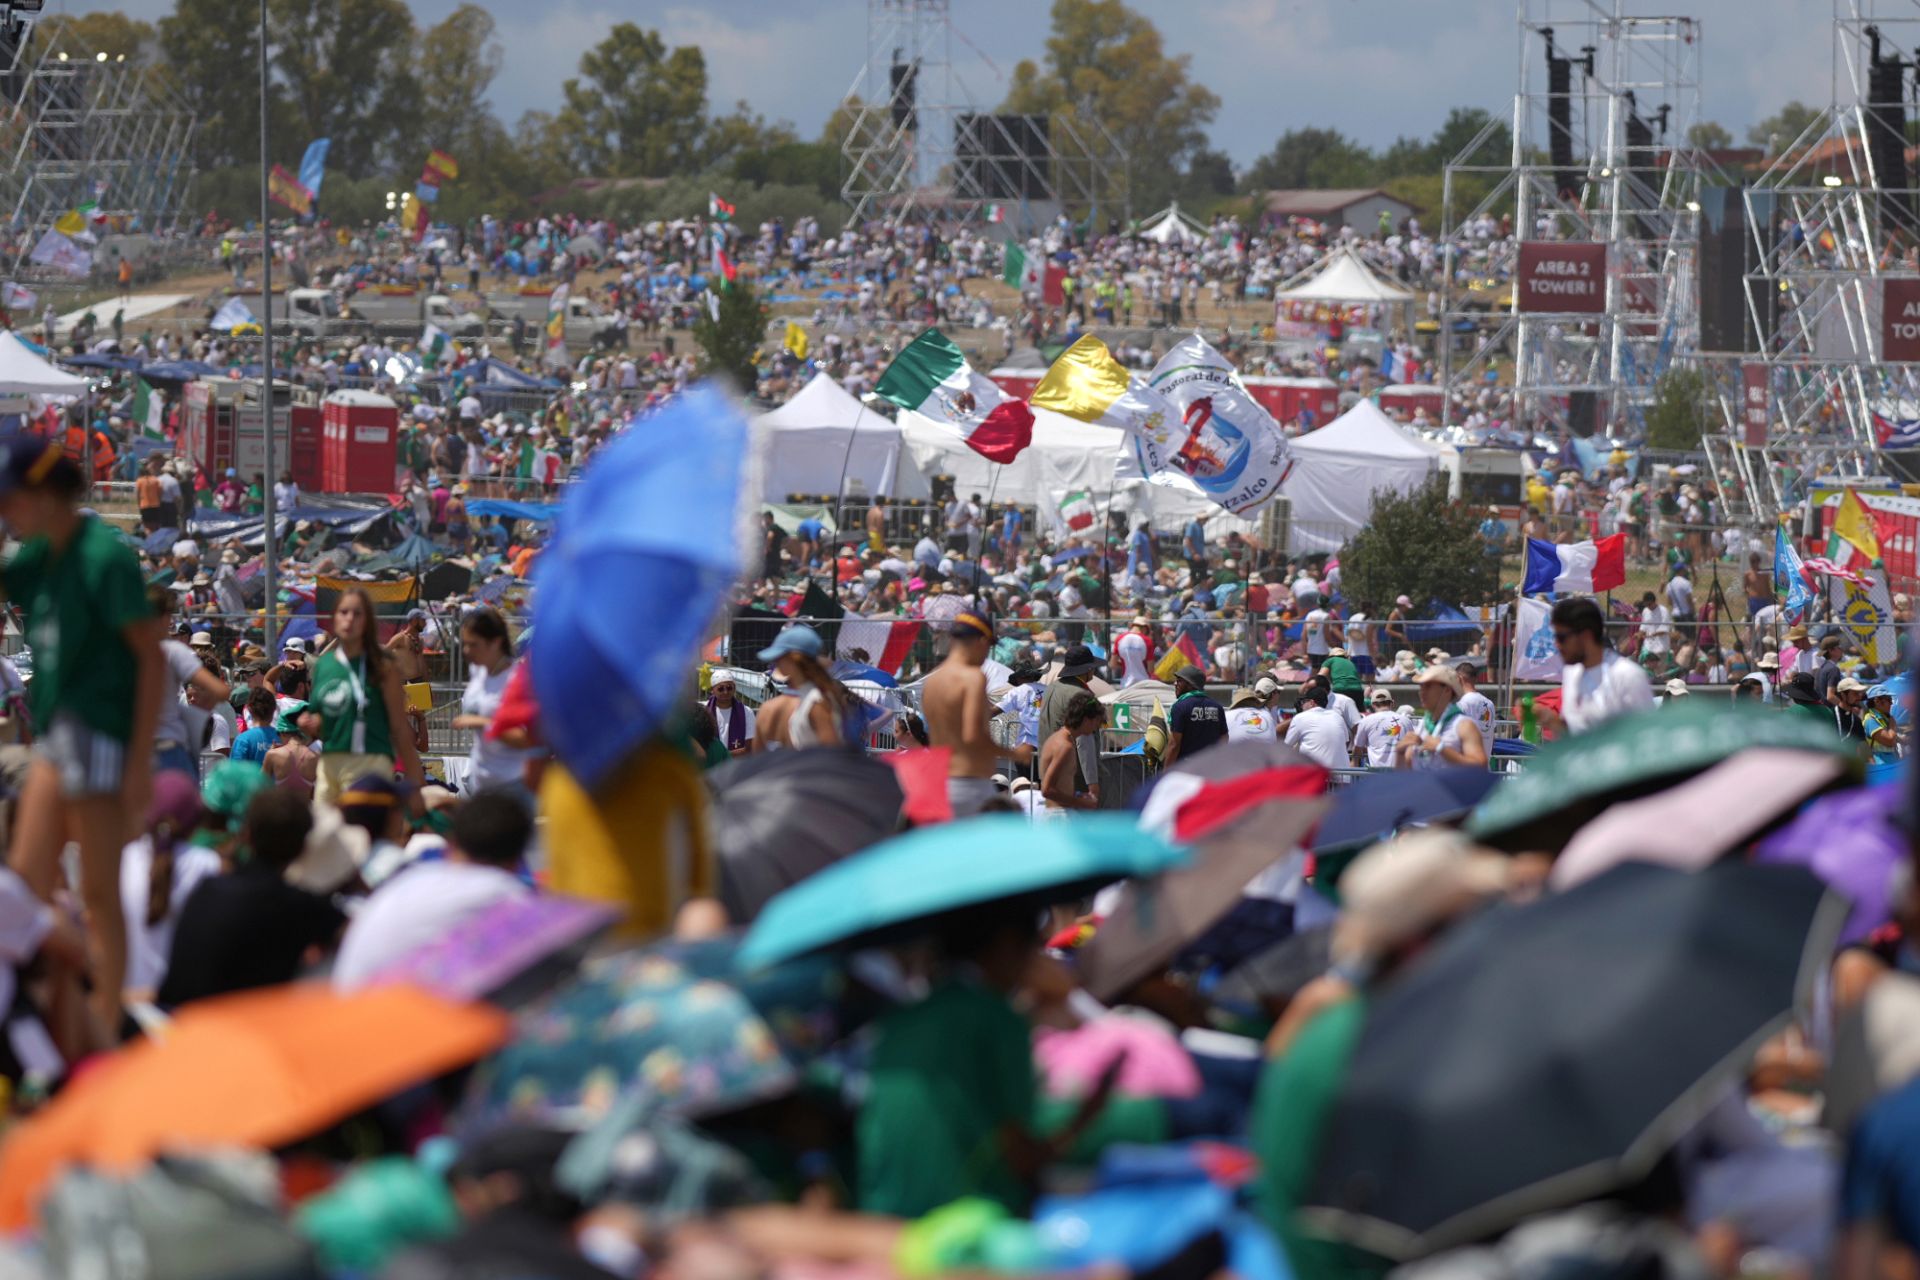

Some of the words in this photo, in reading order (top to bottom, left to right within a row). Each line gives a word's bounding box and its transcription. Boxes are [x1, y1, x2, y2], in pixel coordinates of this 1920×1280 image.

[1535, 261, 1577, 275] AREA
[1580, 262, 1590, 276] 2
[1528, 279, 1587, 294] TOWER
[1158, 371, 1203, 396] Pastoral
[1205, 371, 1220, 383] de
